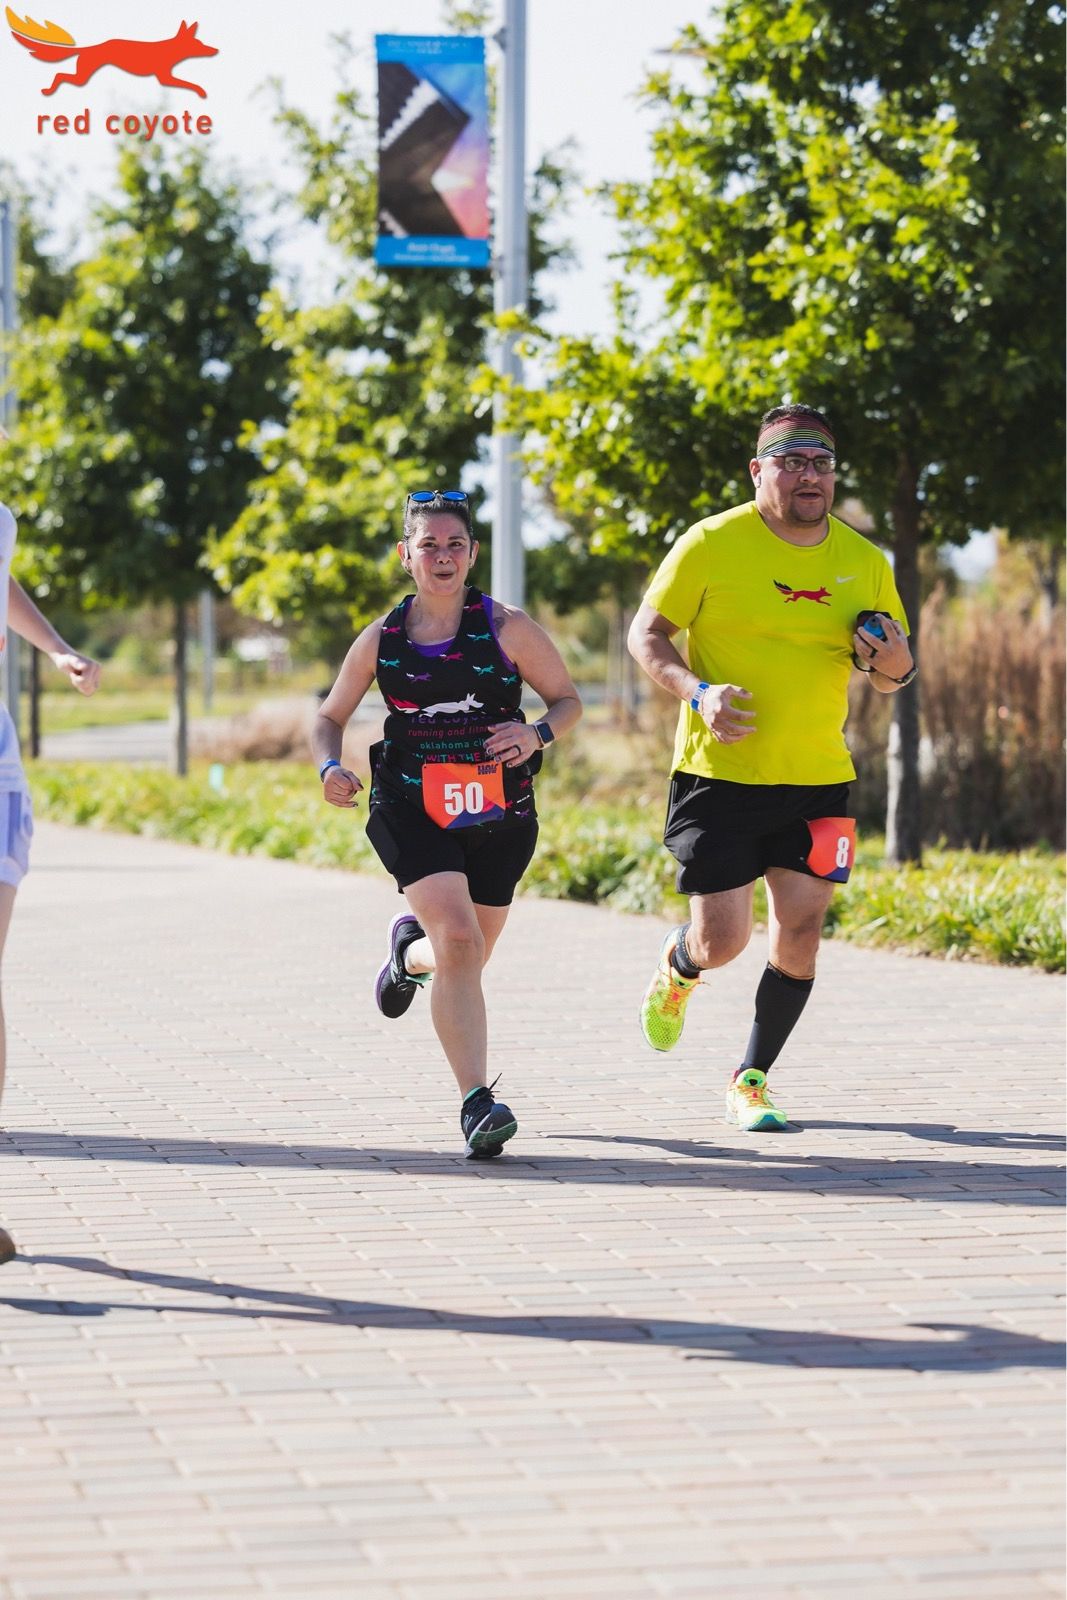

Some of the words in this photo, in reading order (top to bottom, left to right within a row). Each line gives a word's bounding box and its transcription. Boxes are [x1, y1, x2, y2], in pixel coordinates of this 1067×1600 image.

[408, 728, 444, 739] running
[448, 728, 465, 736] and
[420, 741, 469, 750] oklahoma
[427, 754, 456, 762] WITH
[444, 782, 484, 816] 50
[835, 836, 850, 869] 8
